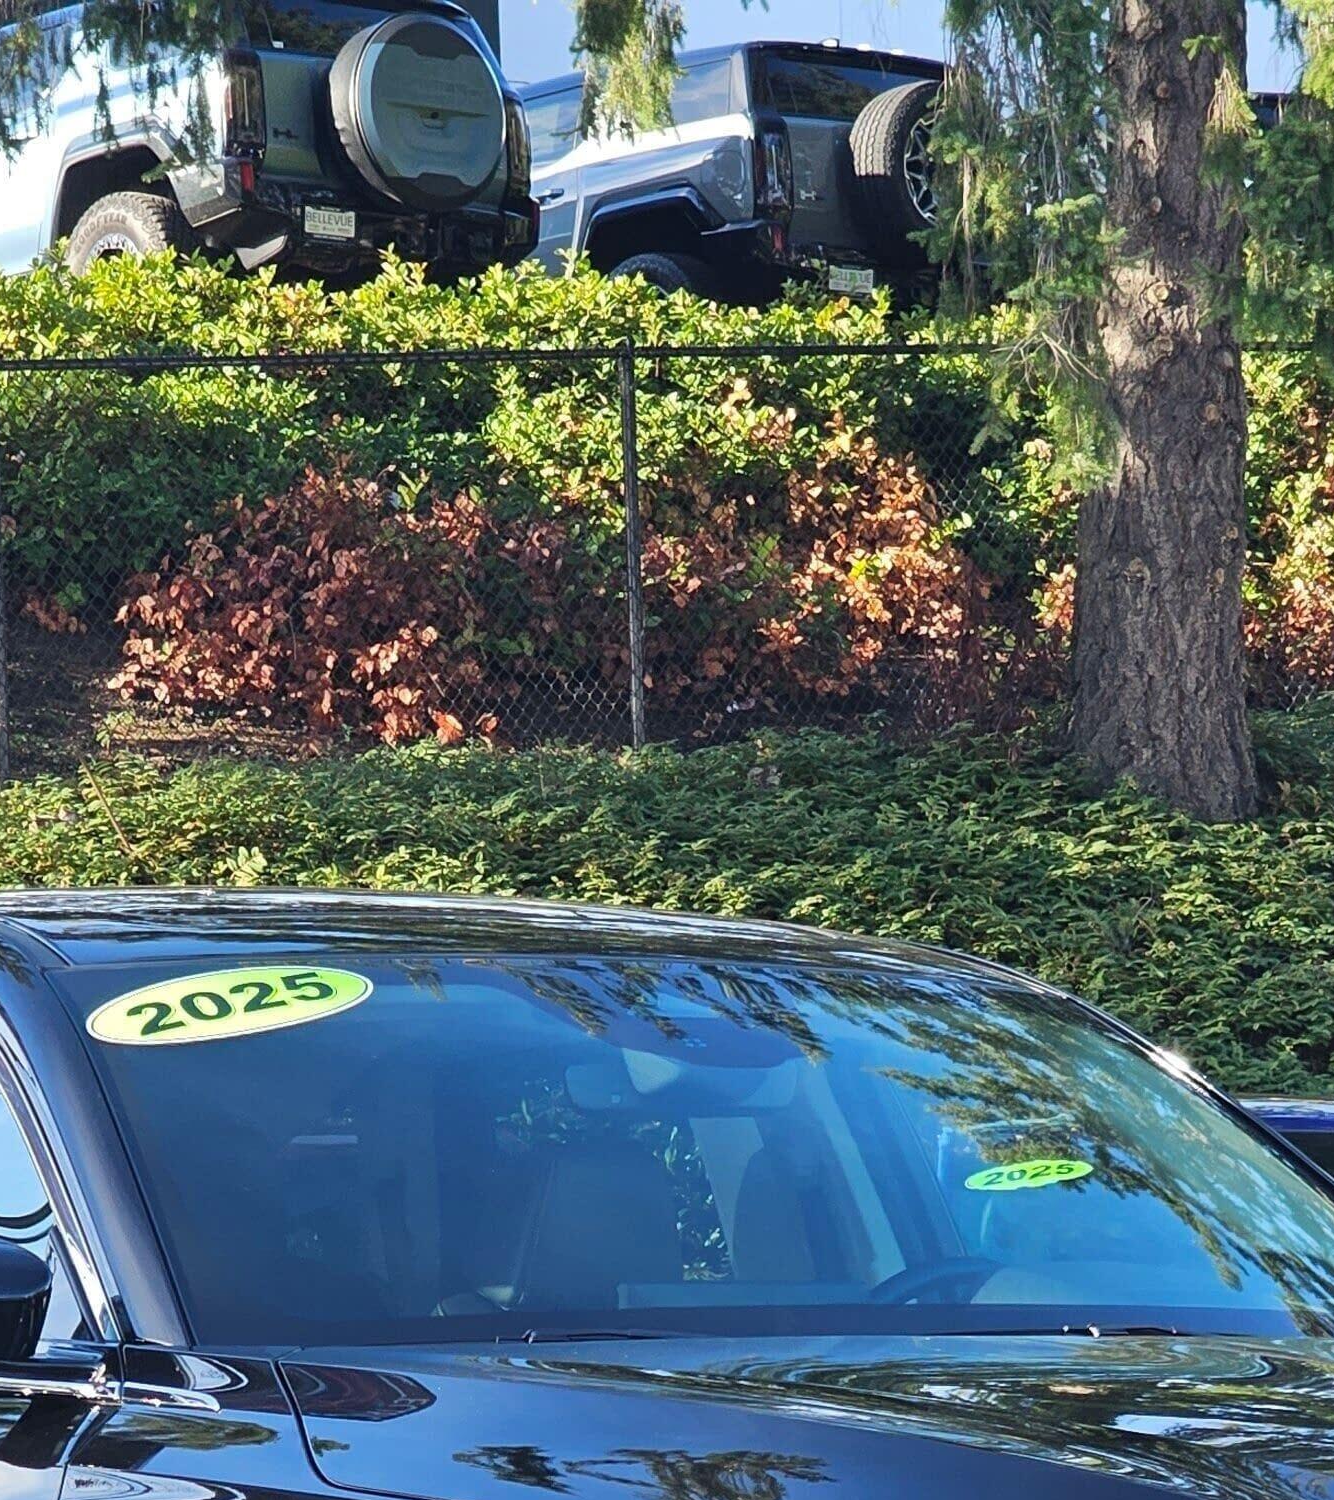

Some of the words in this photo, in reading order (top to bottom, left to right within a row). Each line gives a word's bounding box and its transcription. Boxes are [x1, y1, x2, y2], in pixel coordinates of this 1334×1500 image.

[306, 210, 354, 227] BELLEVUE
[126, 972, 334, 1036] 2025
[983, 1163, 1076, 1186] 2025
